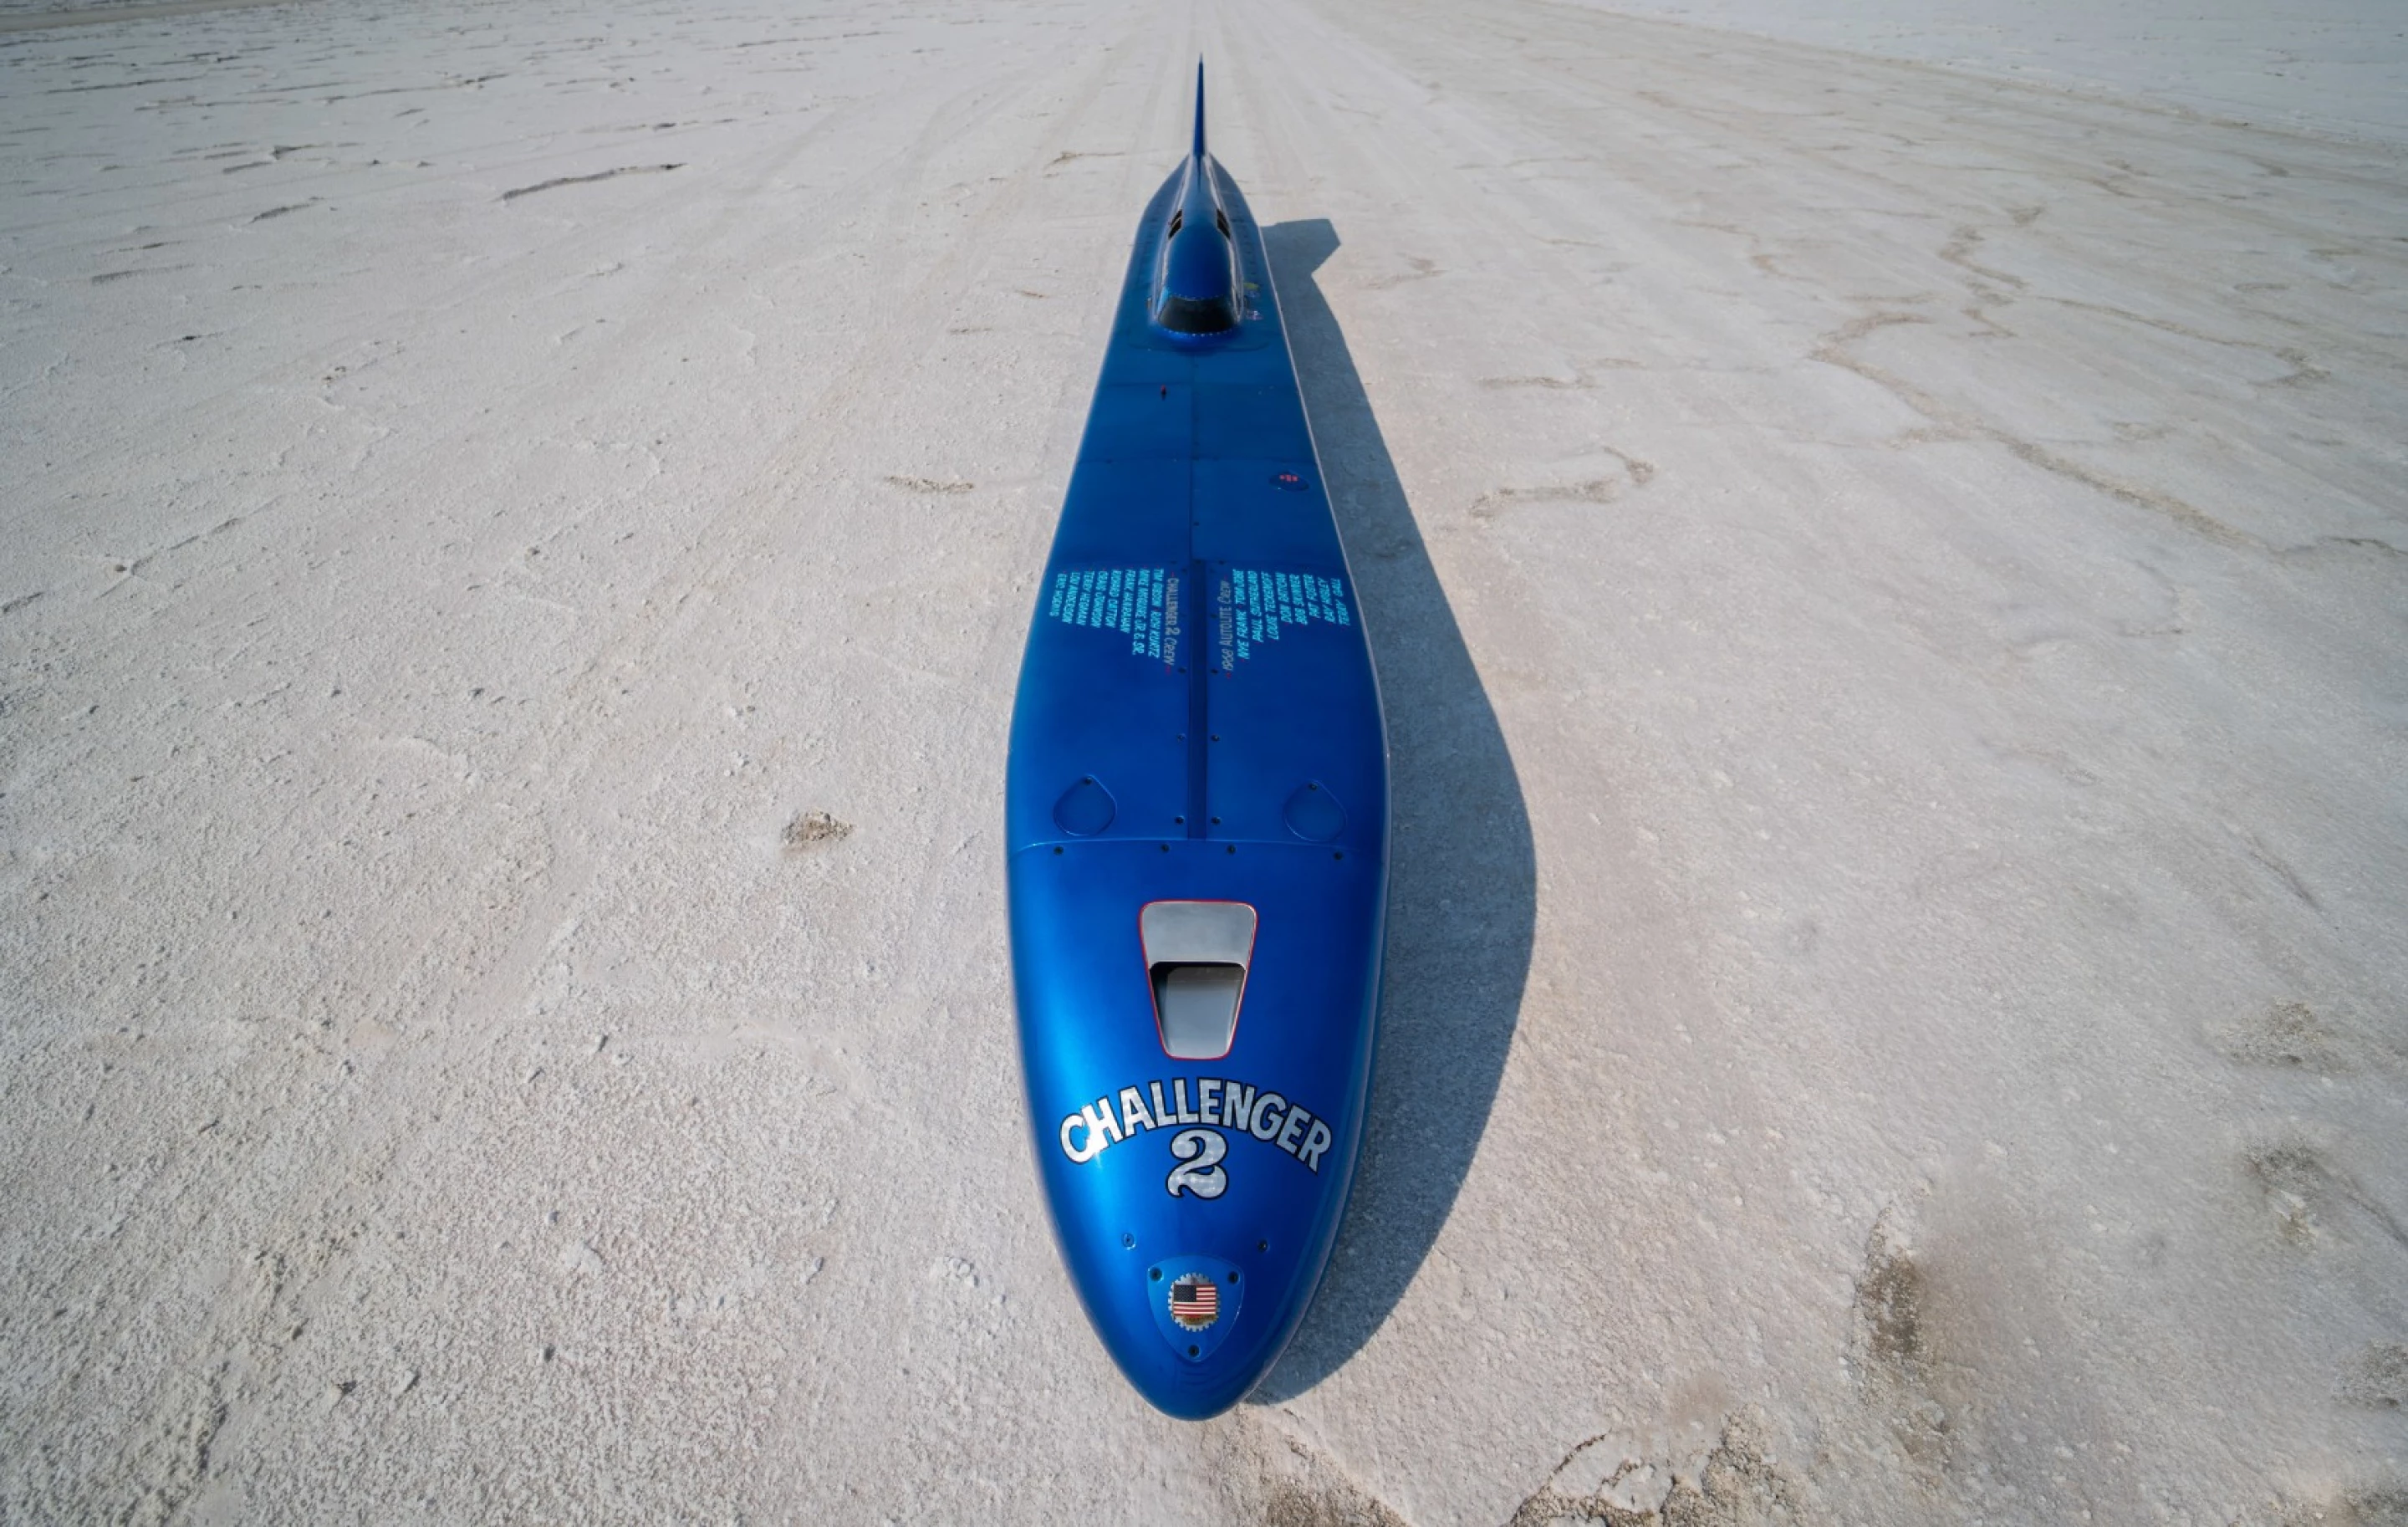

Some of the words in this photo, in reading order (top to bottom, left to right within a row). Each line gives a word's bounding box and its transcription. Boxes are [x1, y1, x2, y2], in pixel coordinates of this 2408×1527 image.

[1083, 571, 1094, 592] TERRY
[1154, 569, 1164, 581] TIM
[1062, 585, 1078, 624] ANDERSON
[1091, 592, 1105, 628] JOHNSON
[1166, 578, 1179, 625] CHALLENGER
[1247, 571, 1262, 616] SUTHERLAND
[1165, 627, 1181, 636] 2
[1219, 606, 1232, 646] AUTOLITE
[1236, 610, 1247, 638] FRANK
[1252, 619, 1263, 642] PAUL
[1237, 639, 1250, 659] NYE
[1059, 1077, 1332, 1175] CHALLENGER
[1166, 1127, 1229, 1200] 2
